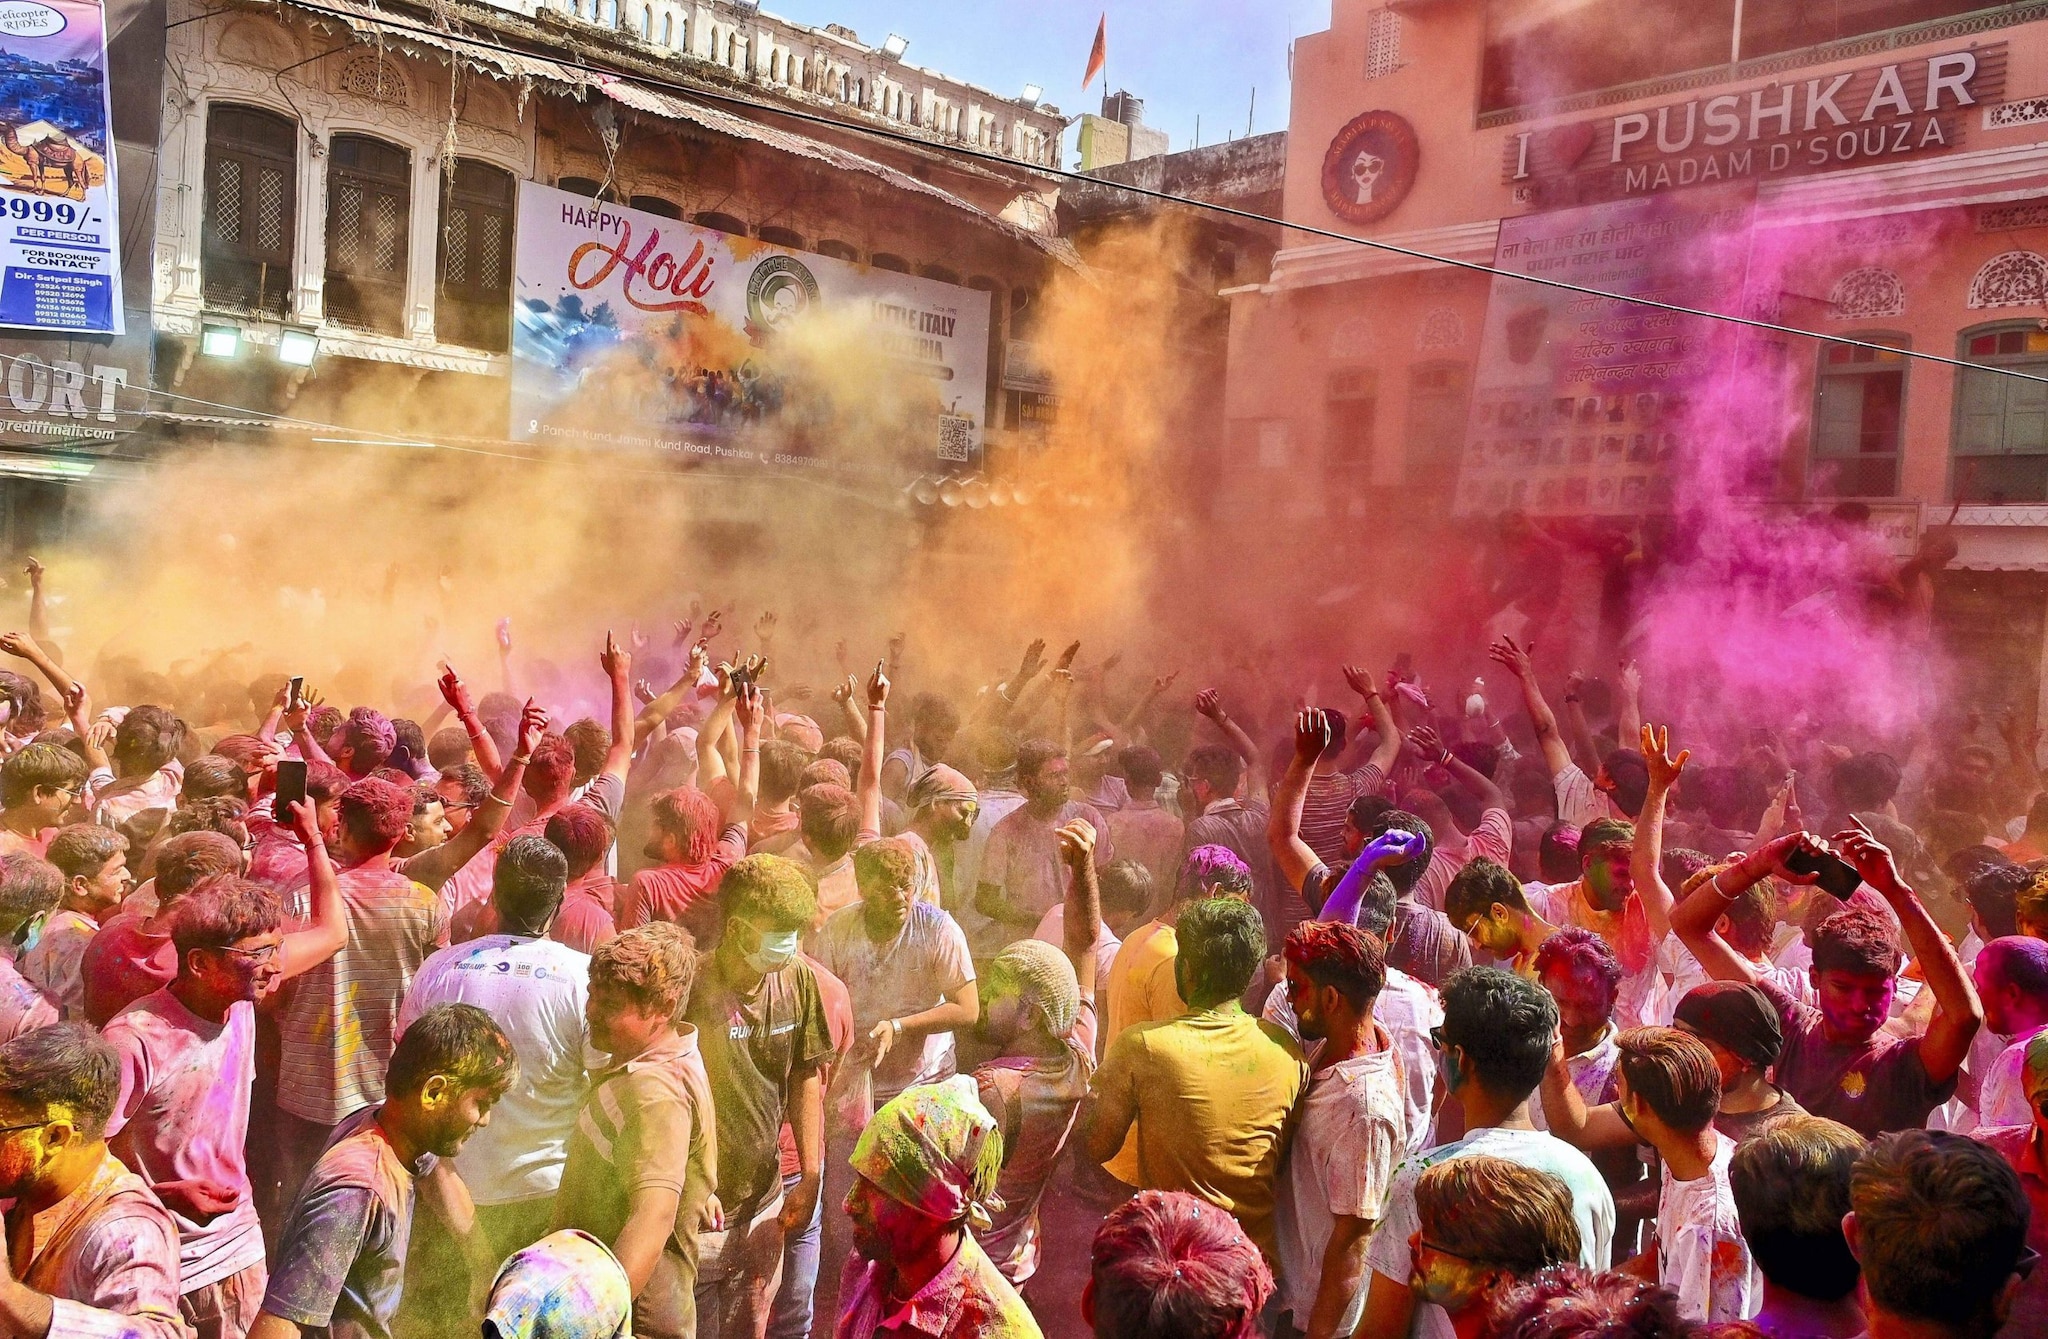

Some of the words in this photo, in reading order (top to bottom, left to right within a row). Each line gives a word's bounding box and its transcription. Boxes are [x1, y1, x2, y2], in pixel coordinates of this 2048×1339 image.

[0, 9, 50, 20] elicopter
[4, 19, 48, 30] RIDES
[1513, 132, 1533, 180] I
[1609, 51, 1977, 163] PUSHKAR
[1625, 150, 1752, 193] MADAM
[1769, 116, 1946, 173] D'SOUZA
[562, 203, 622, 235] HAPPY
[21, 227, 45, 238] PER
[47, 231, 97, 243] PERSON
[1601, 221, 1634, 244] होली
[22, 249, 45, 257] FOR
[47, 252, 101, 262] BOOKING
[27, 257, 97, 269] CONTACT
[73, 277, 103, 287] Singh
[568, 220, 715, 319] Holi
[748, 257, 789, 297] LITTLE
[794, 265, 820, 302] ITAL
[919, 311, 956, 338] ITALY
[1622, 336, 1678, 355] स्वागत
[0, 352, 128, 423] ORT
[542, 425, 579, 438] Panch
[616, 433, 651, 447] Jamni
[654, 438, 681, 451] Kund
[684, 441, 713, 456] Road,
[715, 445, 754, 460] Pushkar
